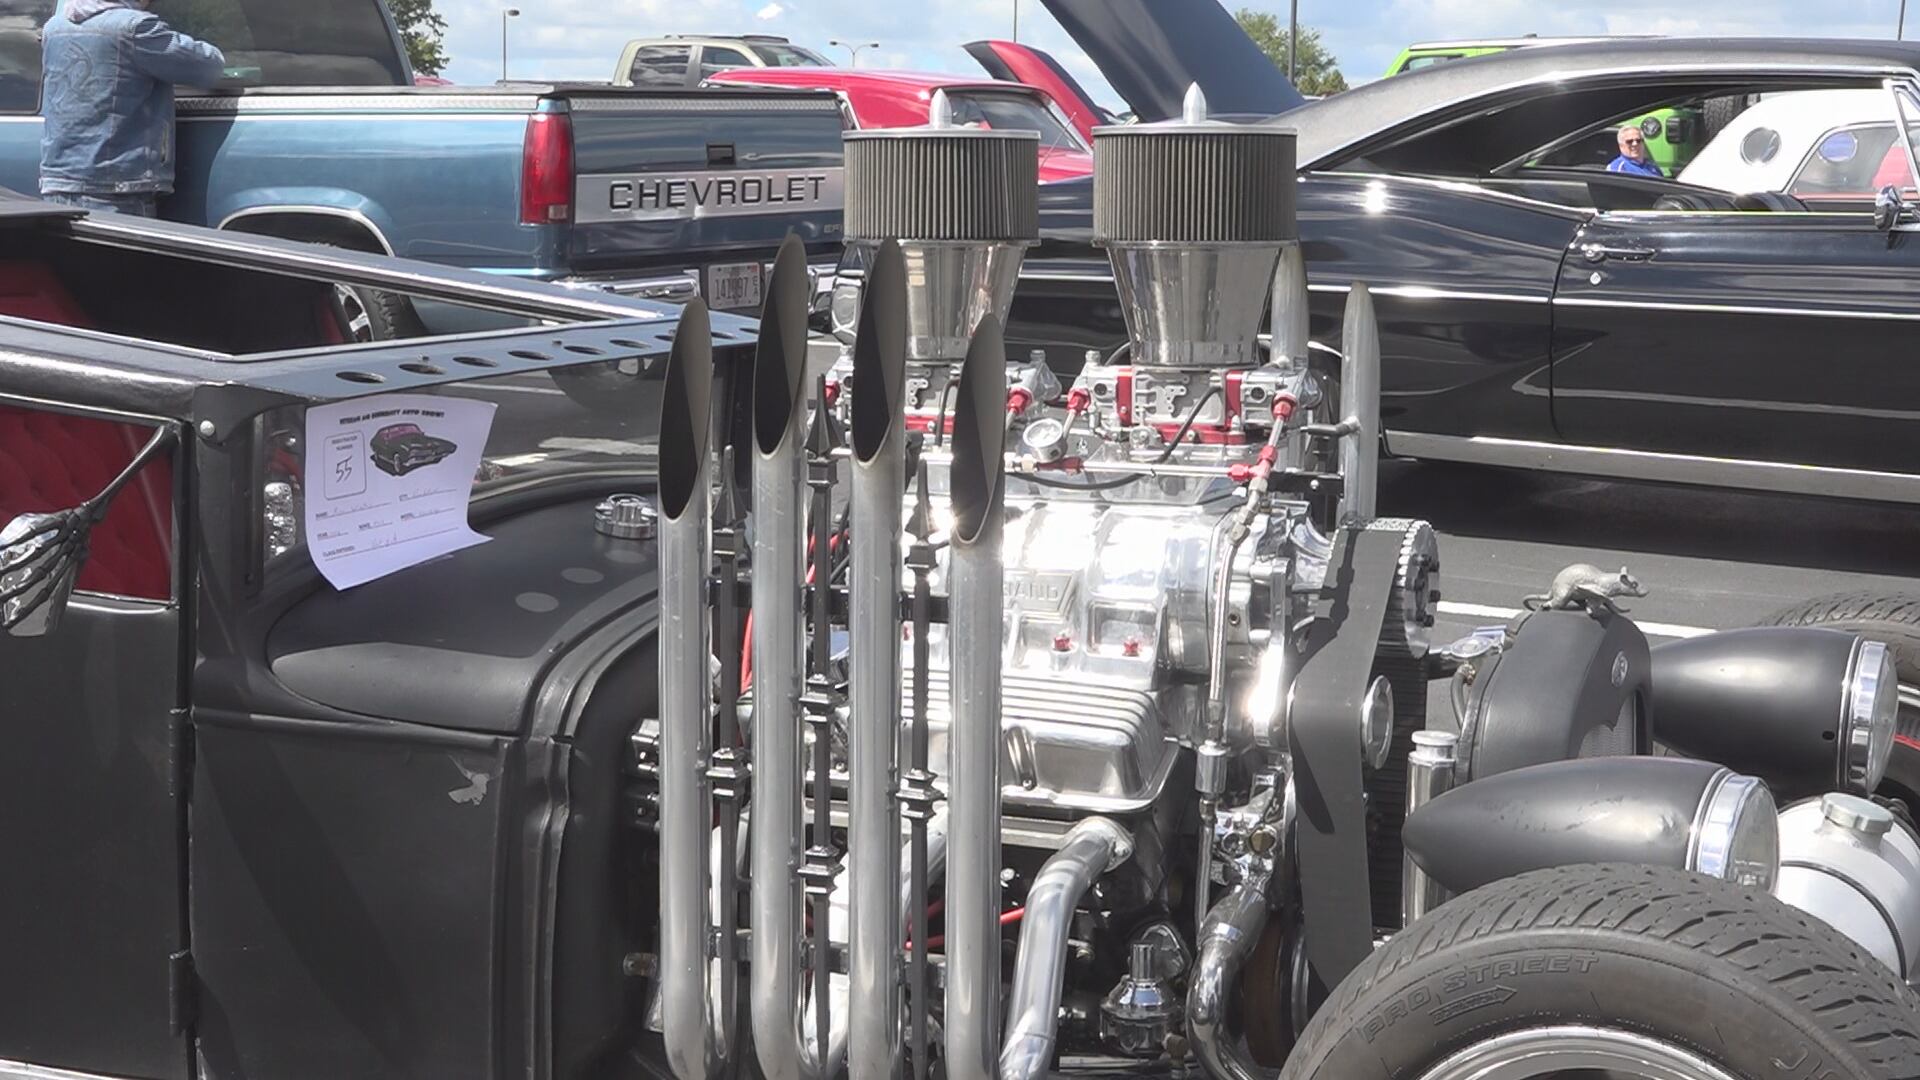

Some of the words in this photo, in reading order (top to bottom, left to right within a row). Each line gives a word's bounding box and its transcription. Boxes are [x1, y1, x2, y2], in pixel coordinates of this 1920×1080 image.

[610, 176, 827, 212] CHEVROLET
[335, 455, 353, 484] 55
[1364, 987, 1432, 1041] PRO
[1443, 954, 1600, 993] STREET
